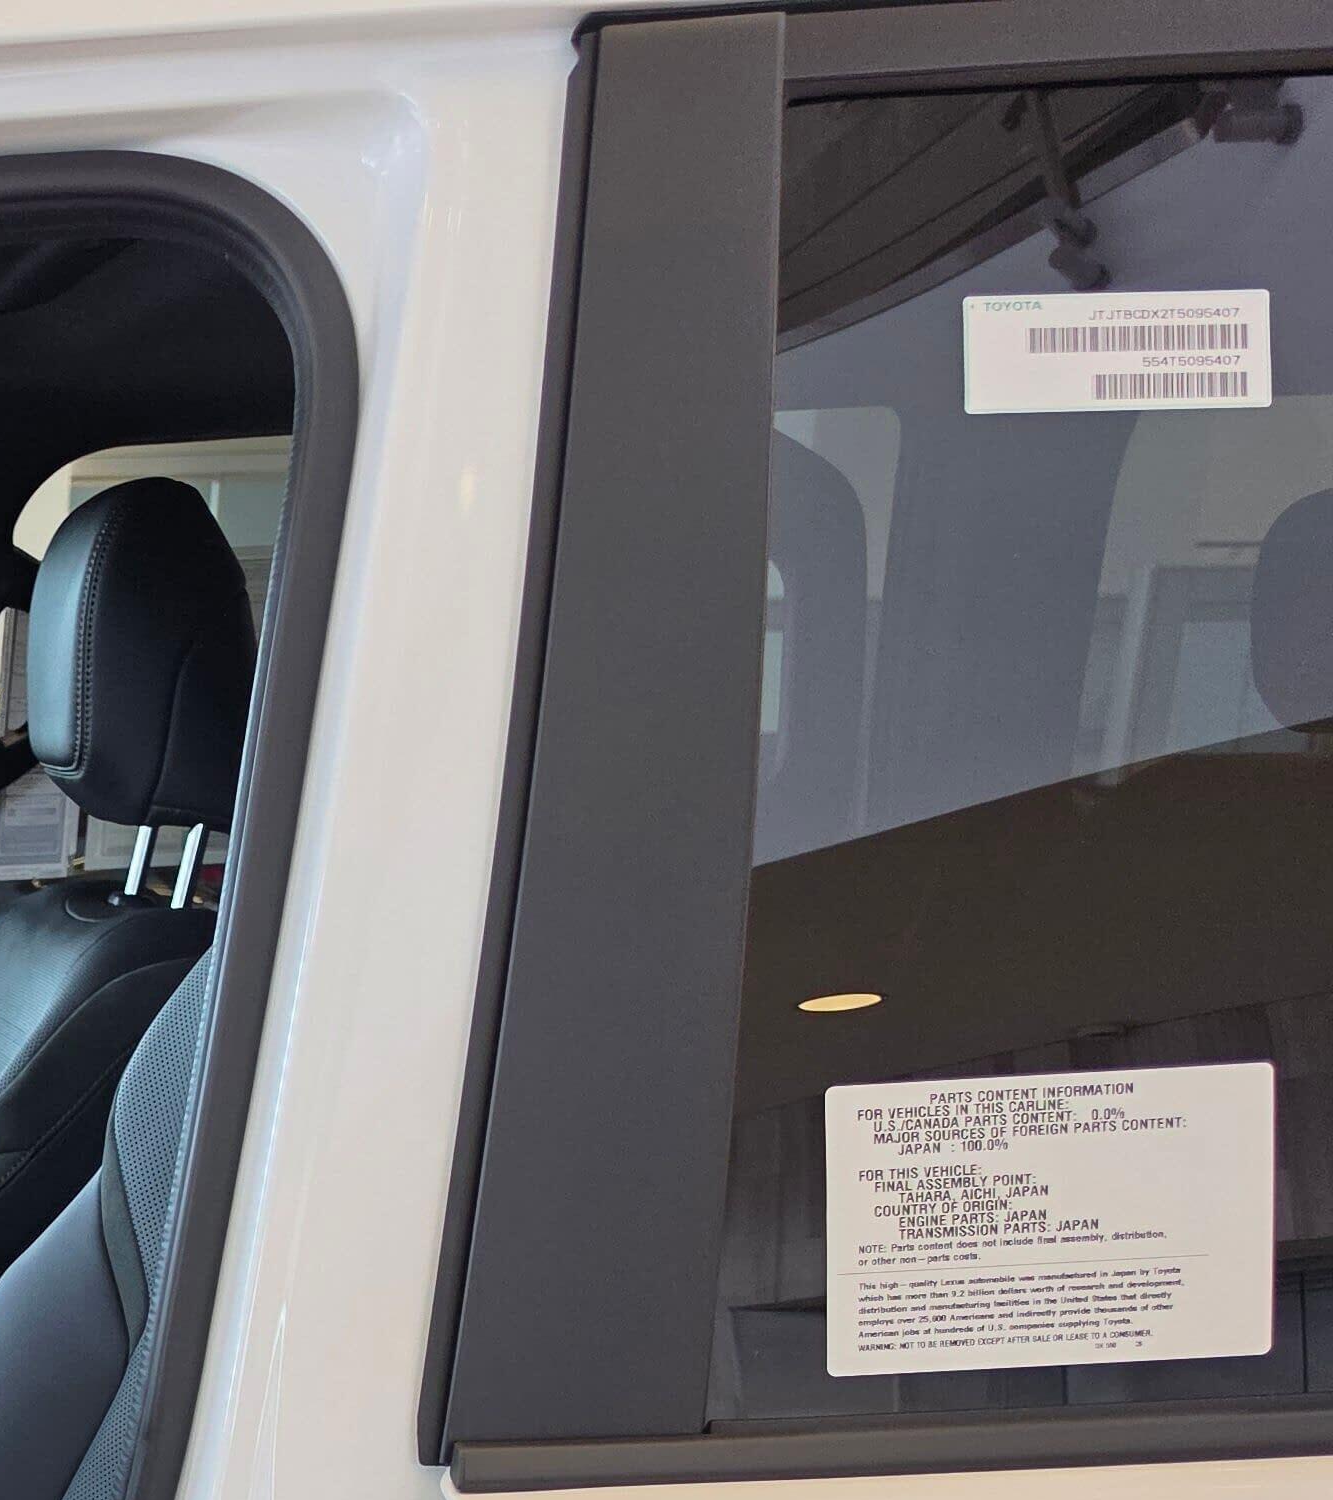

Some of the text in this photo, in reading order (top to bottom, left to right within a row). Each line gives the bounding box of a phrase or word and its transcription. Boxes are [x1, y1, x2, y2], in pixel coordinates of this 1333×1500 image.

[983, 301, 1042, 312] TOYOTA
[1142, 355, 1241, 367] 554T5095407
[930, 1083, 1133, 1104] PARTS CONTENT INFORMATION
[858, 1099, 1068, 1120] FOR VEHICLES IN THIS CARLINE:
[965, 1114, 1007, 1127] PARTS
[1013, 1111, 1076, 1124] CONTENT:
[1092, 1108, 1124, 1120] 0.0%
[874, 1117, 1186, 1144] MAJOR SOURCES OF FOREIGN PARTS CONTENT:
[898, 1143, 940, 1155] JAPAN
[961, 1139, 1008, 1151] 100.0%
[859, 1164, 981, 1181] FOR THIS VEHICLE:
[875, 1174, 1036, 1192] FINAL ASSEMBLY POINT:
[899, 1185, 1048, 1203] TAHARA, AICHI, JAPAN
[875, 1199, 1012, 1217] COUNTRY OF ORIGIN:
[899, 1210, 1046, 1228] ENGINE PARTS: JAPAN
[899, 1219, 1098, 1239] TRANSMISSION PARTS: JAPAN
